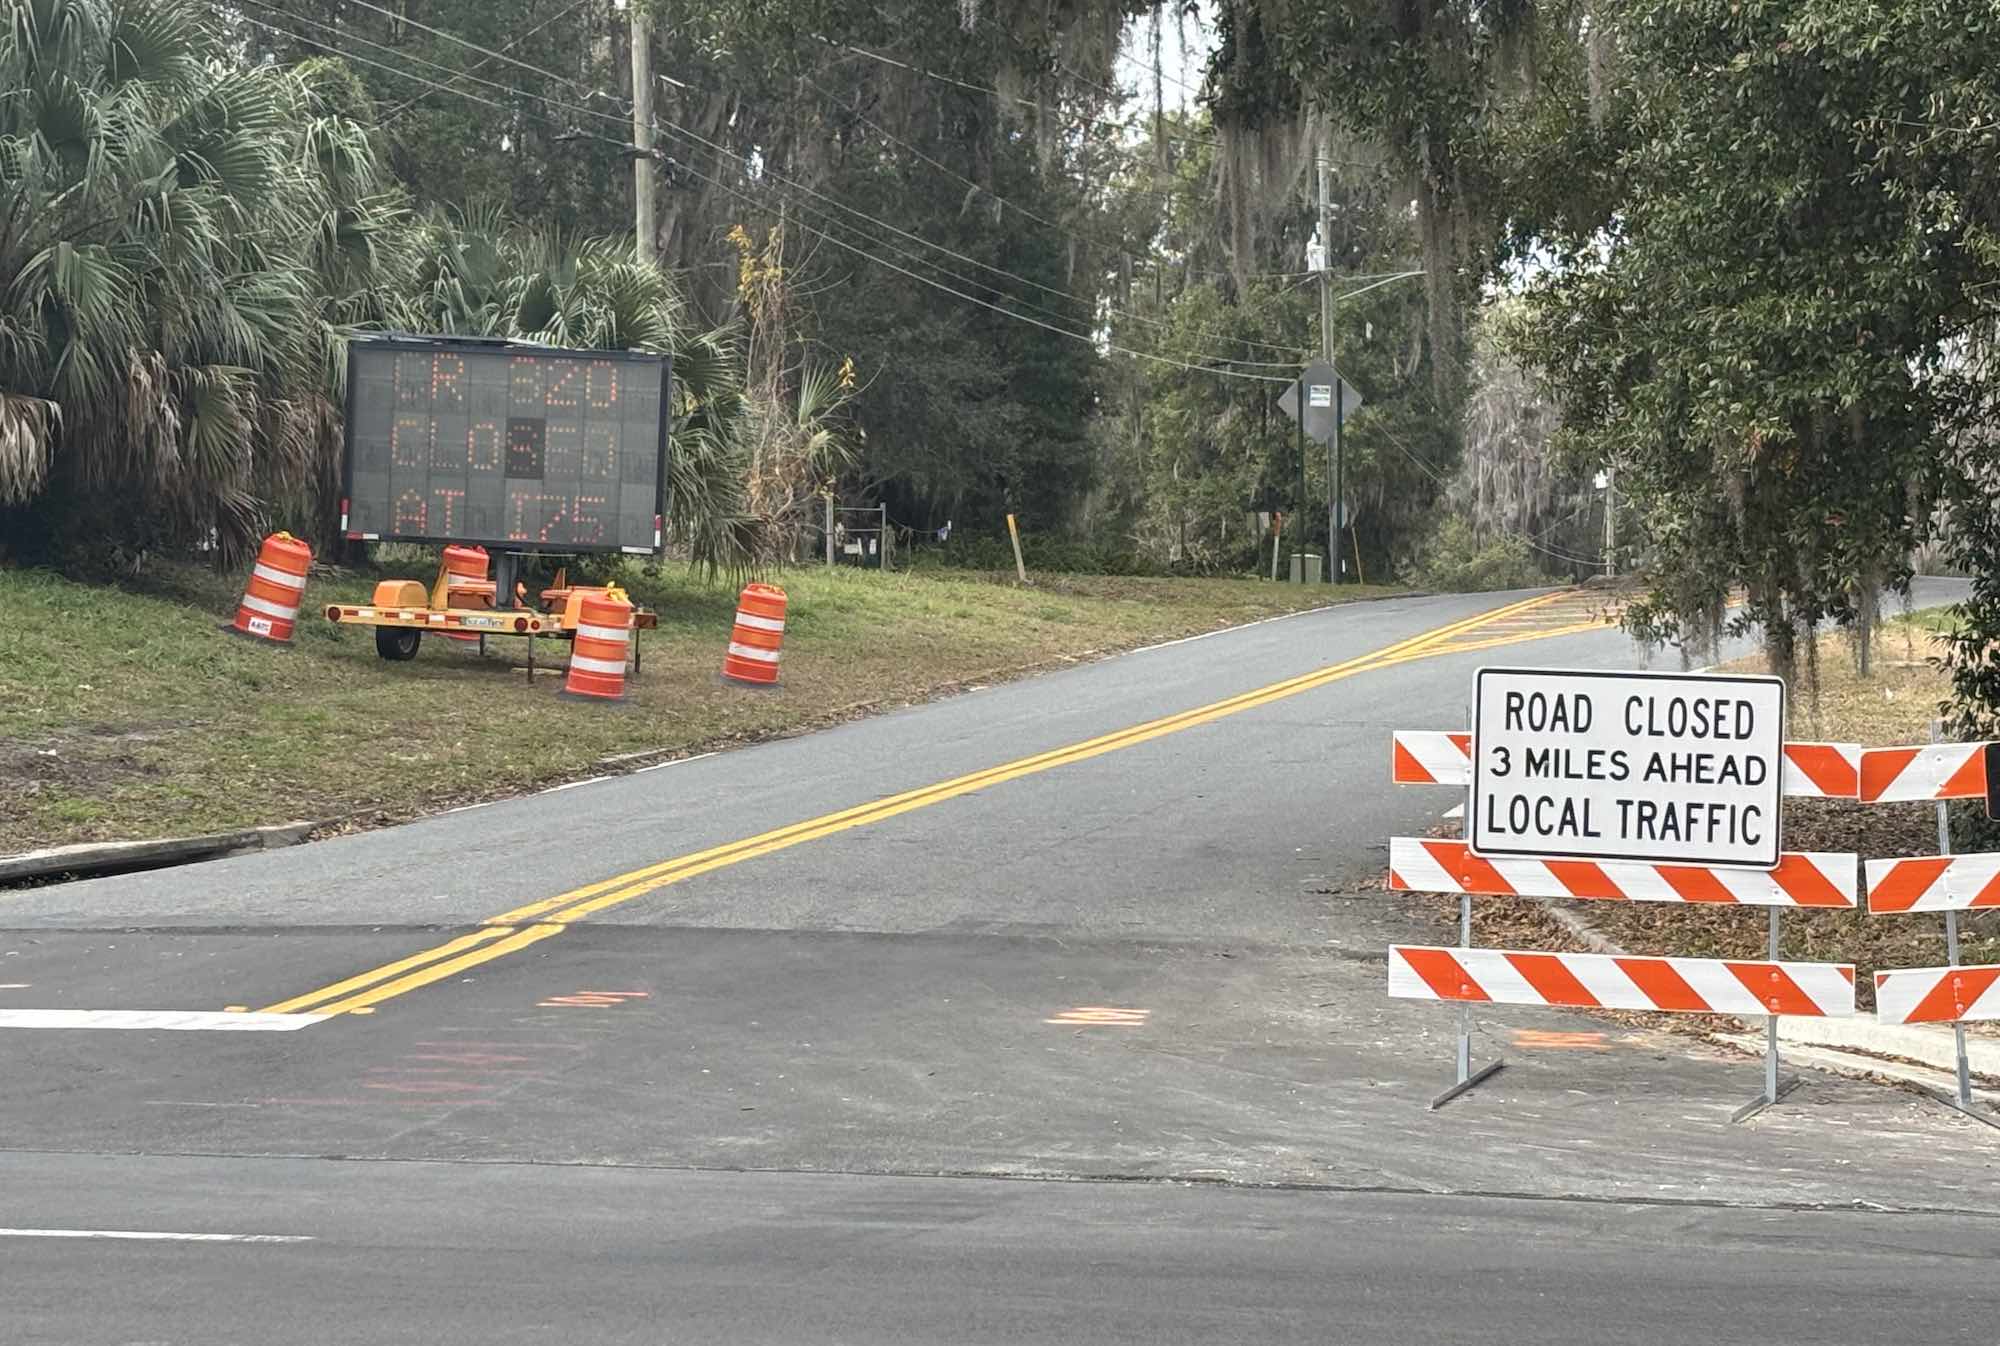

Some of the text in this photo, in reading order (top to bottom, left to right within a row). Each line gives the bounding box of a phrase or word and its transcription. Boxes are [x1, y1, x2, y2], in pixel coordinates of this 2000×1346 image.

[394, 352, 464, 401] CR
[392, 419, 614, 476] CLOSED
[395, 488, 465, 536] AT
[1505, 691, 1754, 740] ROAD CLOSED
[1490, 746, 1767, 786] 3 MILES AHEAD
[1487, 794, 1761, 846] LOCAL TRAFFIC
